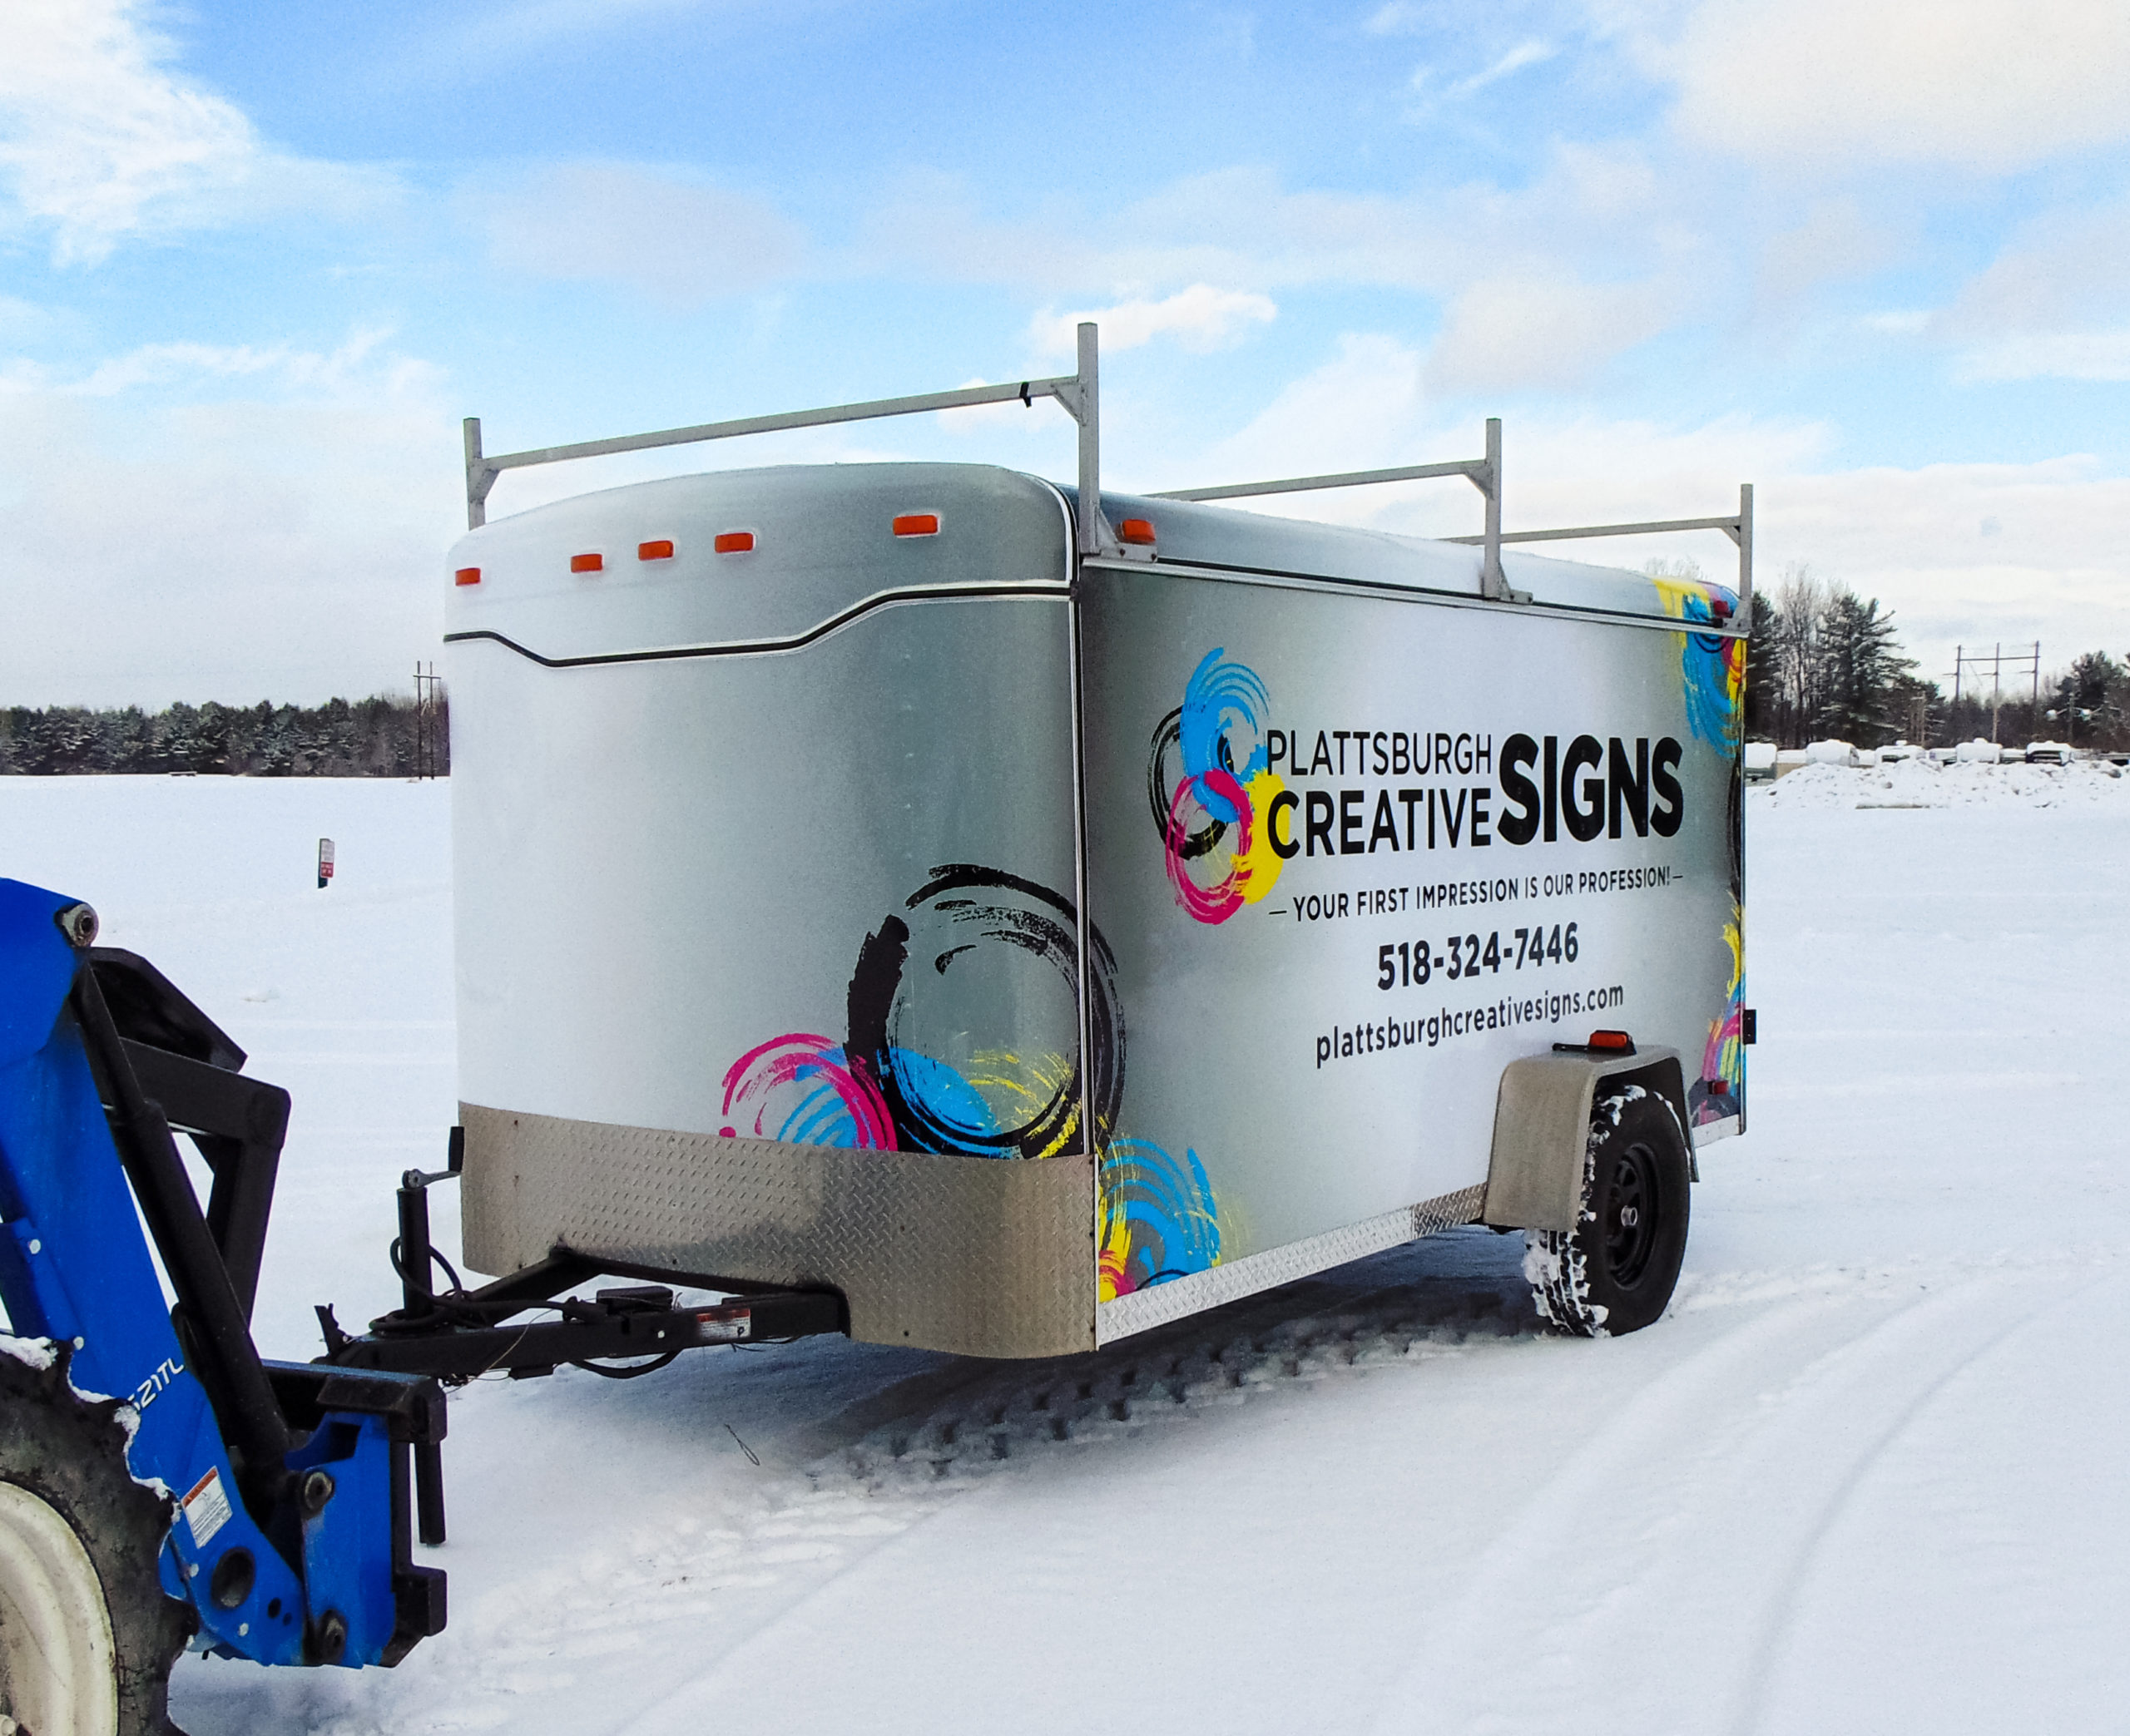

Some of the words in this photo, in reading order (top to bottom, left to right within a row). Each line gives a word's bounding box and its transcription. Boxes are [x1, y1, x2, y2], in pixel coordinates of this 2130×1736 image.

[1267, 730, 1491, 776] PLATTSBURGH
[1267, 788, 1491, 859] CREATIVE
[1497, 733, 1684, 845] SIGNS
[1293, 893, 1349, 922] YOUR
[1357, 888, 1409, 916] FIRST
[1417, 878, 1518, 910] IMPRESSION
[1525, 876, 1538, 899] IS
[1543, 873, 1573, 898] OUR
[1579, 866, 1670, 893] PROFESSION!
[1377, 922, 1578, 991] 518-324-7446
[1316, 985, 1624, 1068] plattsburghcreativesigns.com
